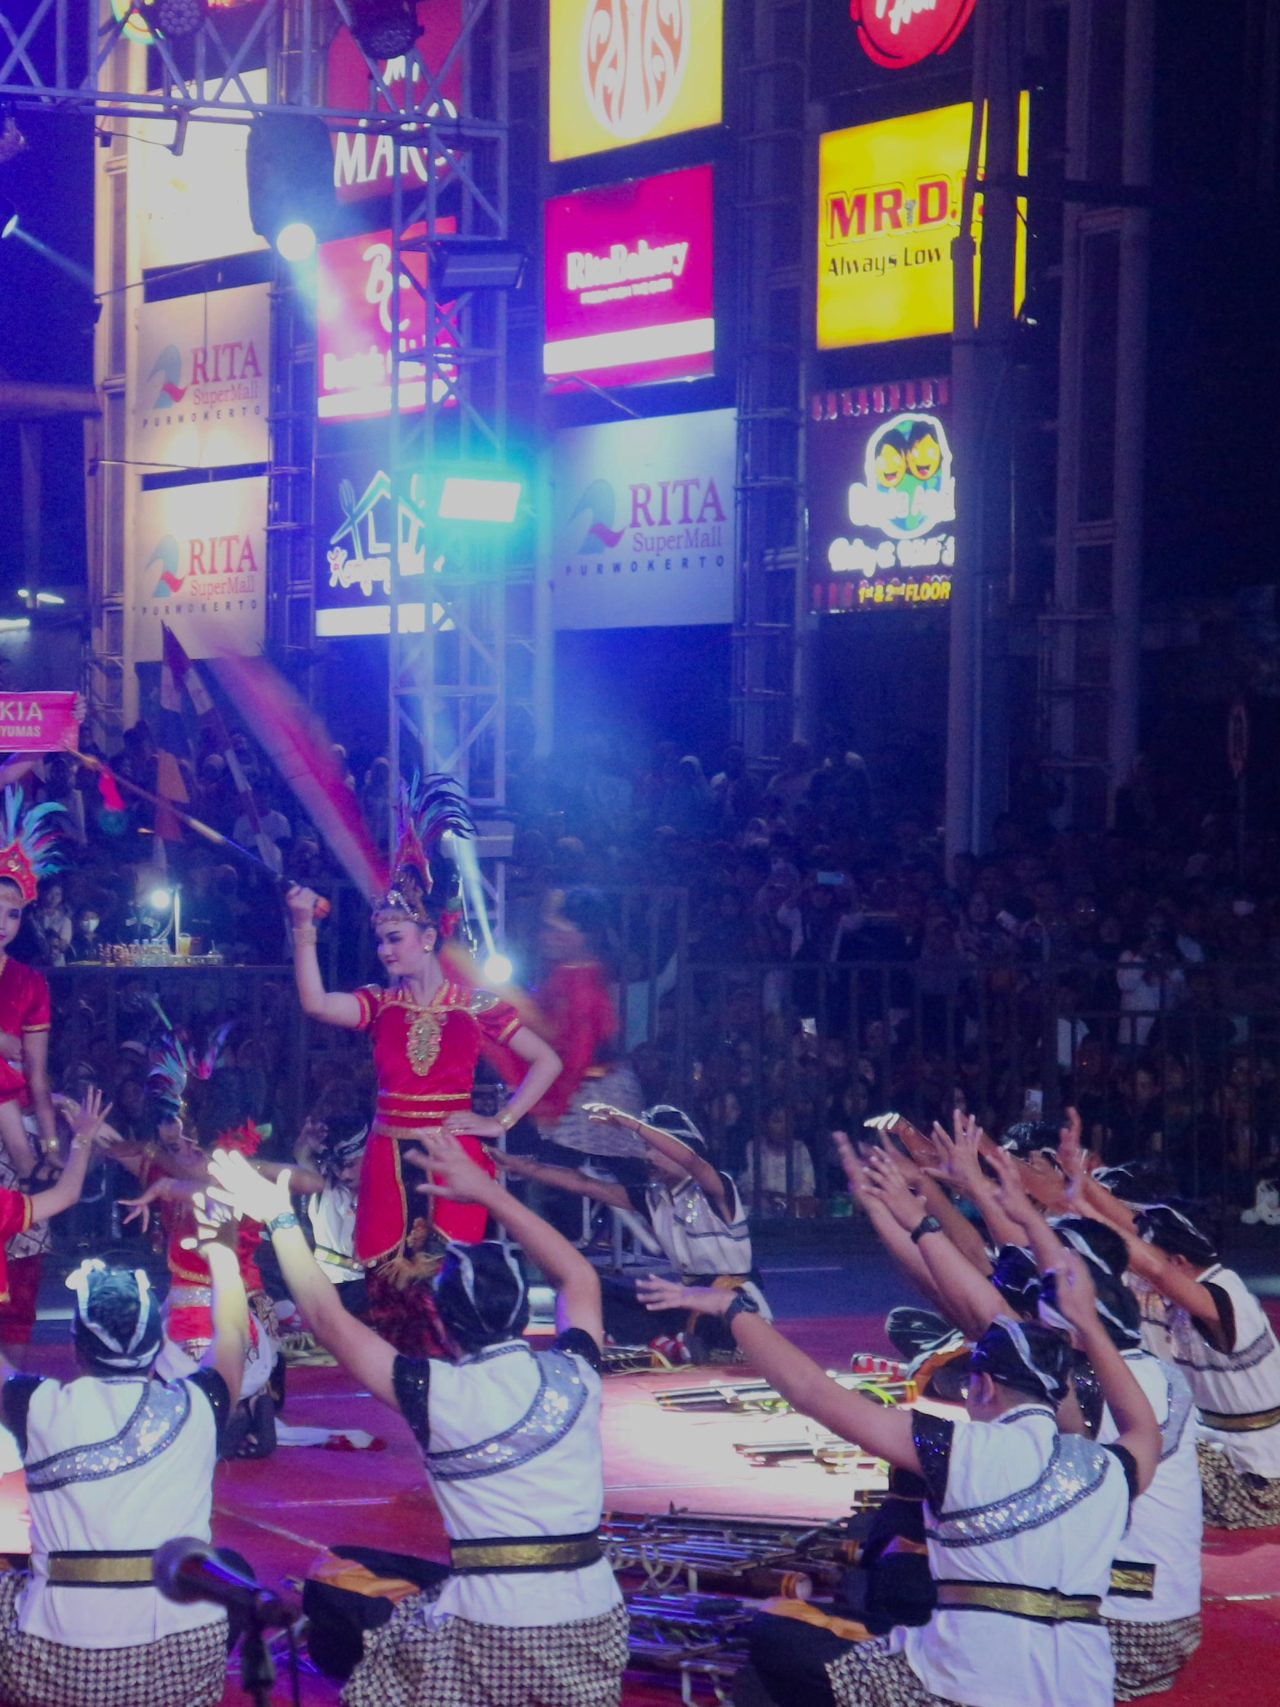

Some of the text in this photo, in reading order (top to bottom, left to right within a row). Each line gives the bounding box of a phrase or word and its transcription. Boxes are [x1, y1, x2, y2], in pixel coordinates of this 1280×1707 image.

[828, 246, 941, 277] Always Low
[192, 340, 262, 385] RITA
[193, 381, 259, 409] SuperMall
[143, 405, 261, 428] PURWOKERTO
[628, 477, 728, 529] RITA
[632, 525, 723, 557] SuperMall
[188, 534, 258, 577] RITA
[565, 555, 725, 577] PURWOKERTO
[190, 574, 255, 601] SuperMall
[905, 581, 952, 602] FLOOR
[142, 600, 256, 617] PURWOKERTO
